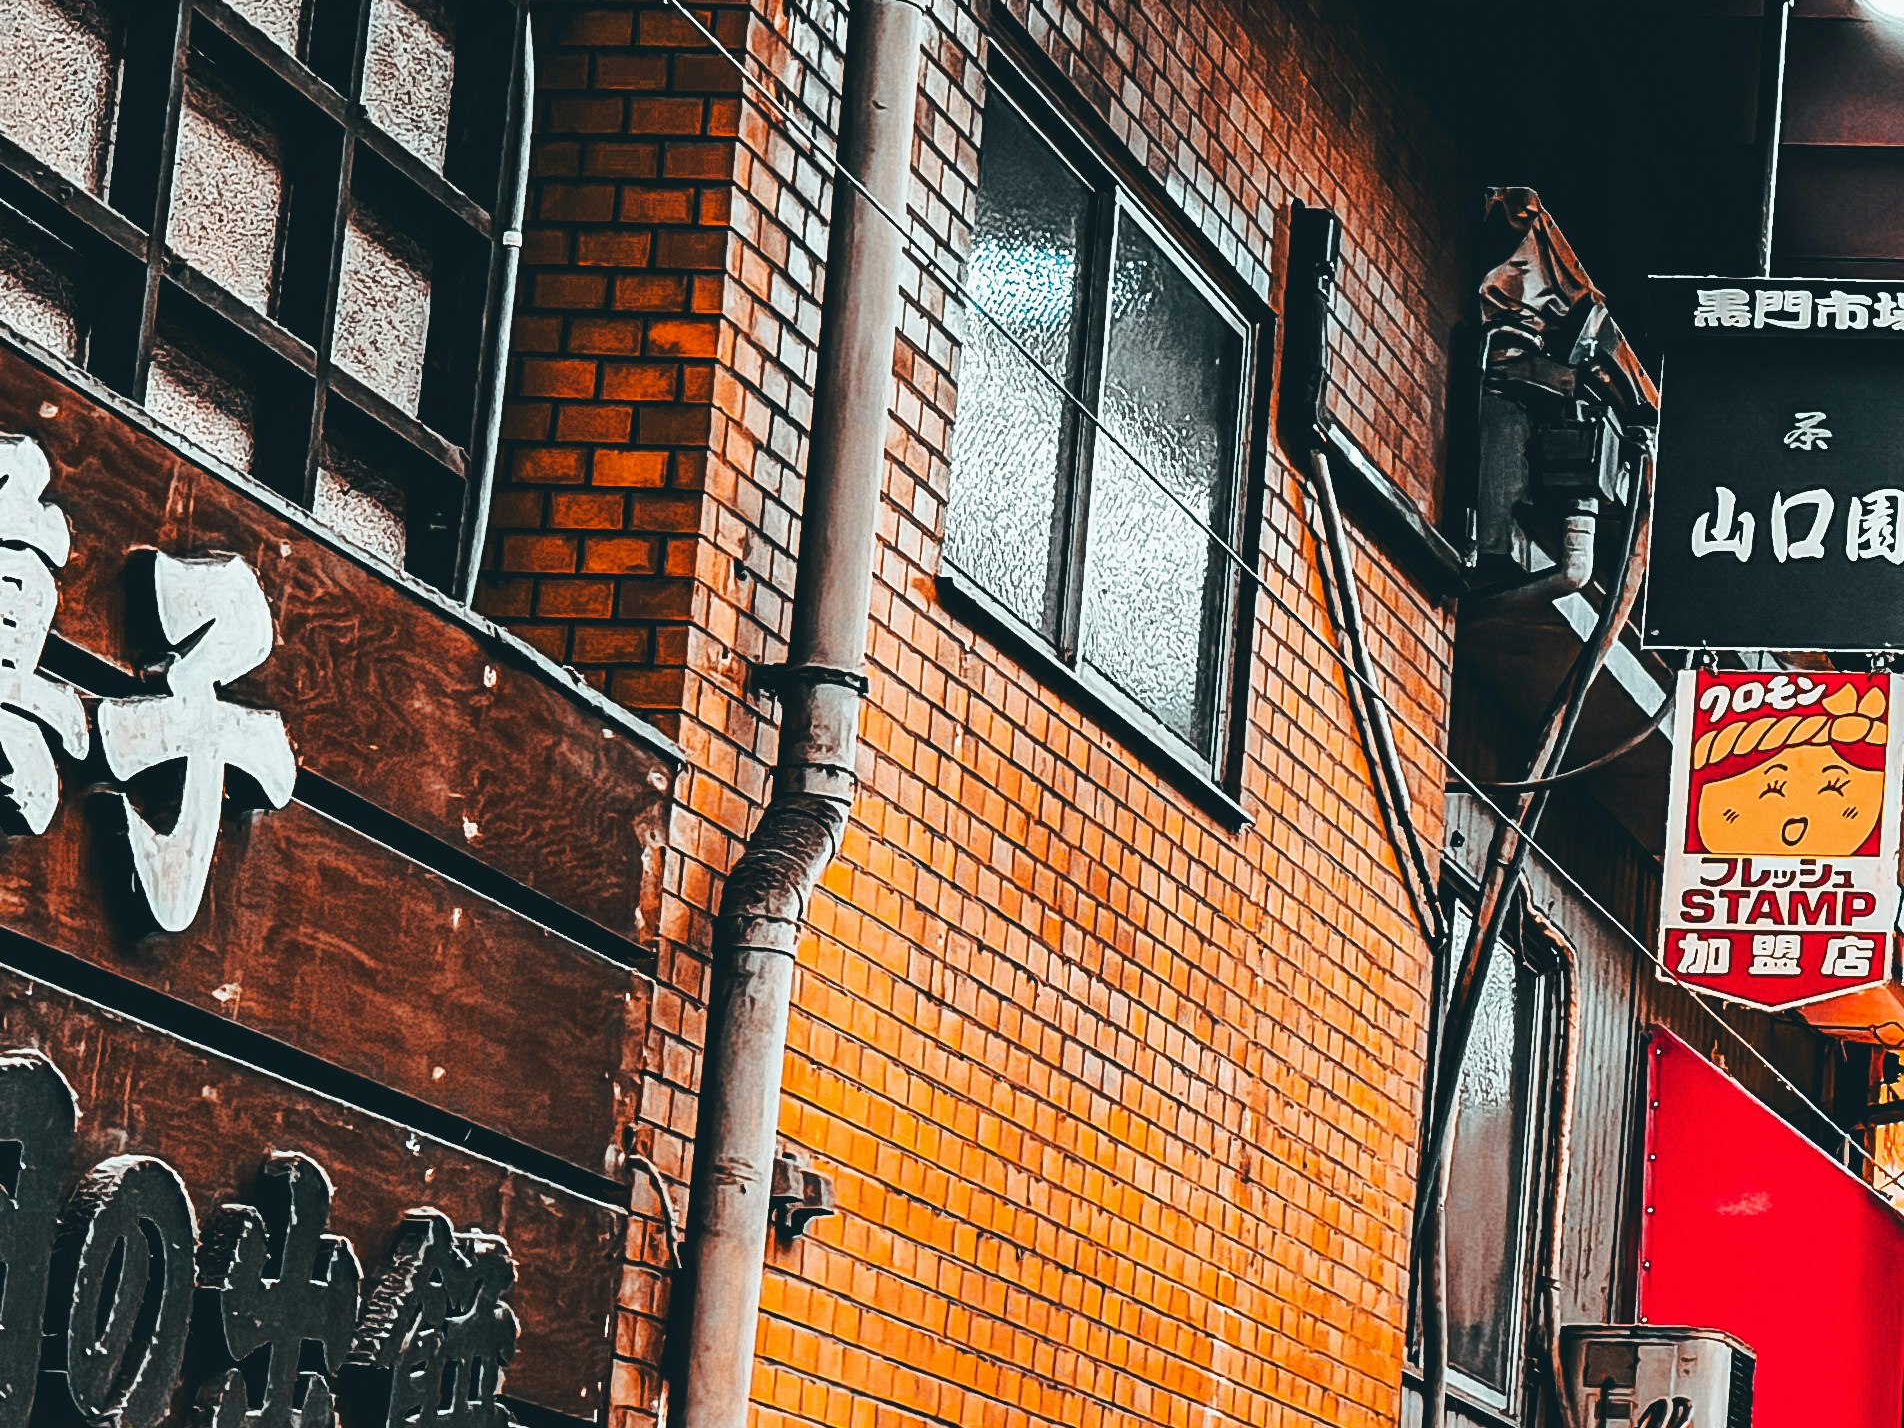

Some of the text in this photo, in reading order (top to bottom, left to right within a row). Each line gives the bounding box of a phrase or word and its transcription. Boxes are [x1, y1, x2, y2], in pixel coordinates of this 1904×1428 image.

[1699, 679, 1827, 723] クロモン
[1698, 856, 1855, 890] フレッシュ
[1679, 890, 1878, 927] STAMP
[1677, 933, 1876, 978] 加盟店
